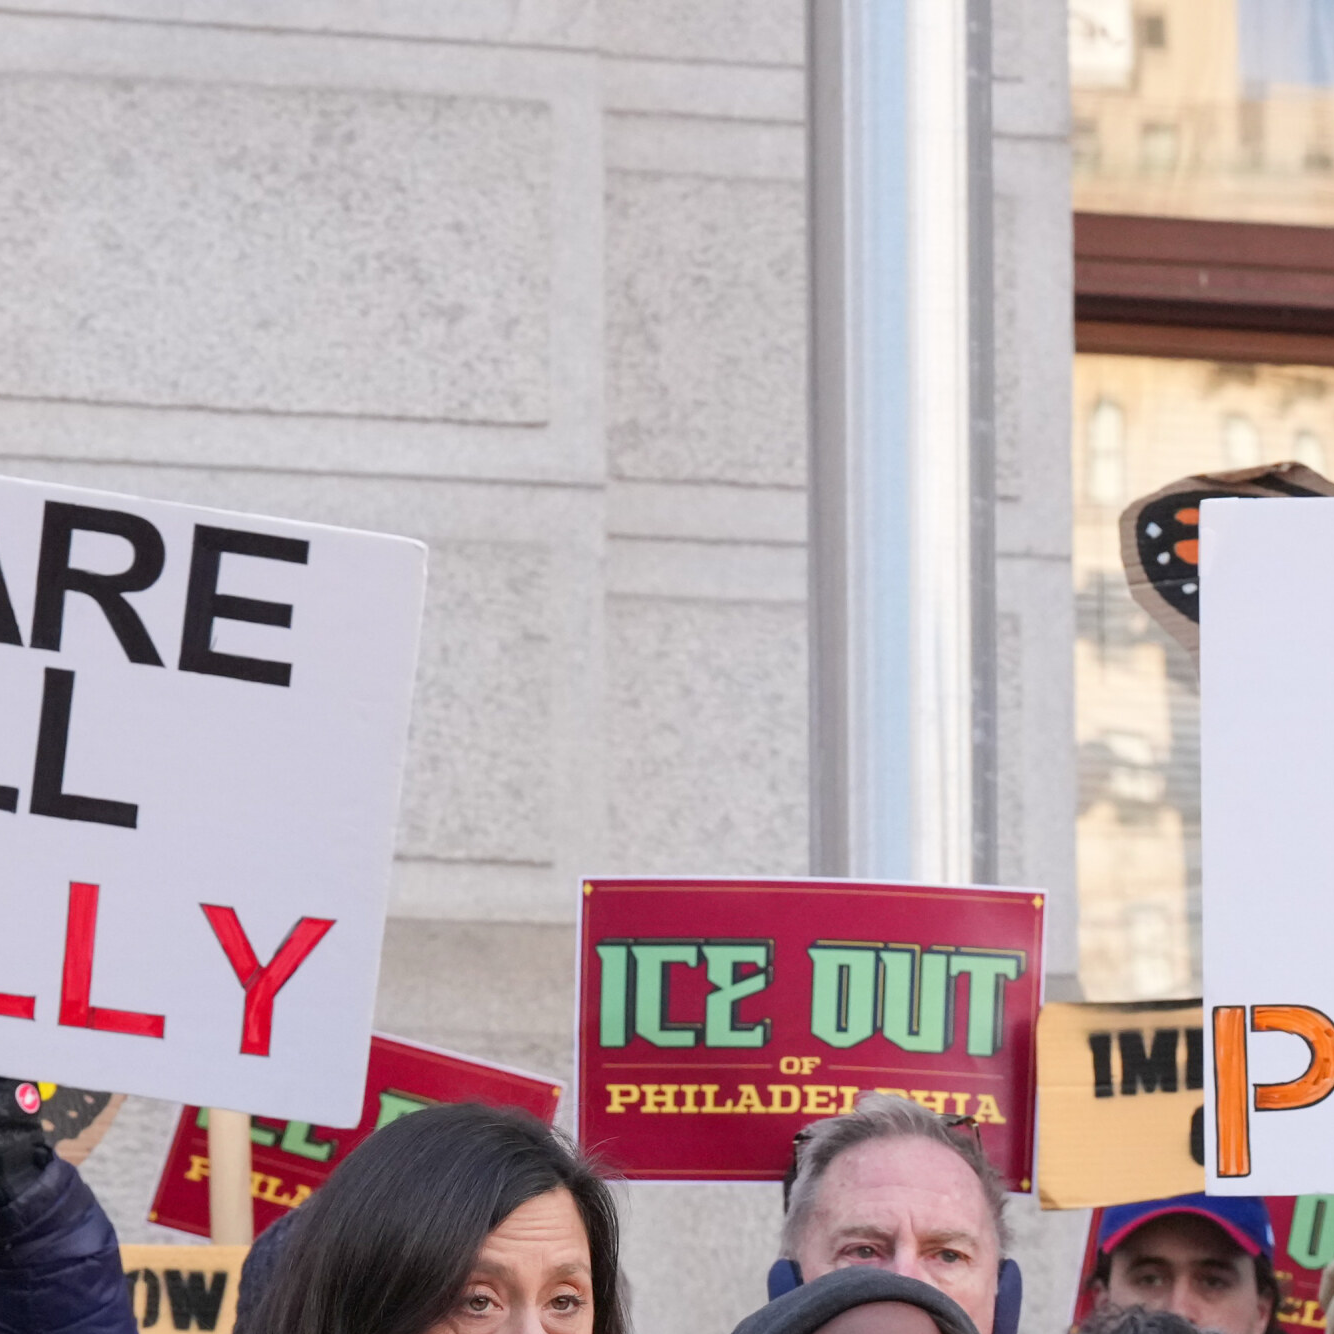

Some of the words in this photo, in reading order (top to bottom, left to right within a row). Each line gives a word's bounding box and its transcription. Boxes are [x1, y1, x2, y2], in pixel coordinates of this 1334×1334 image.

[595, 938, 774, 1050] ICE
[808, 939, 1026, 1057] OUT
[779, 1056, 822, 1076] OF
